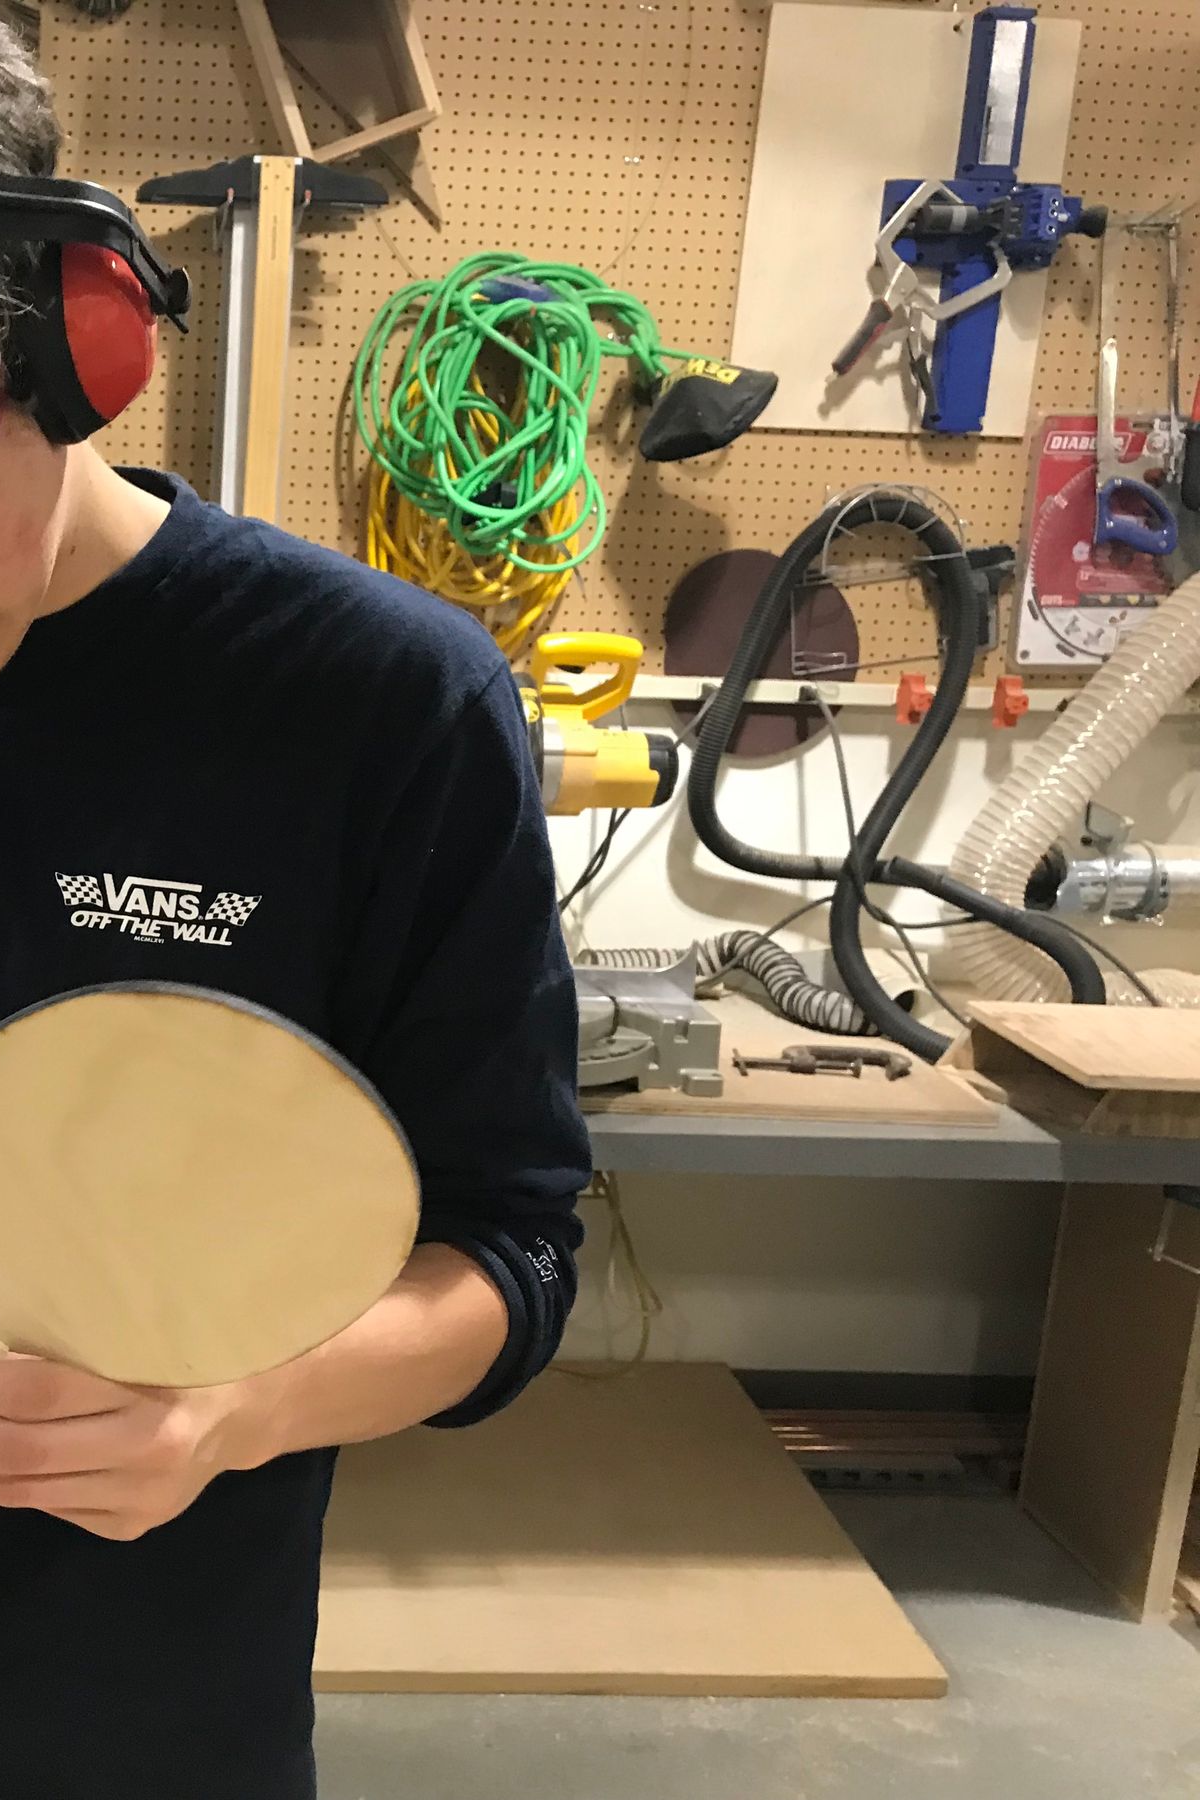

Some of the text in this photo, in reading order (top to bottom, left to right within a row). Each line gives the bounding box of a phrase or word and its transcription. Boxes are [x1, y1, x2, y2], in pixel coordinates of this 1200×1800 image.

[1050, 435, 1124, 451] DIABL
[103, 873, 202, 920] VANS
[70, 910, 233, 946] OFF THE WALL
[133, 935, 165, 945] MCMLXVI
